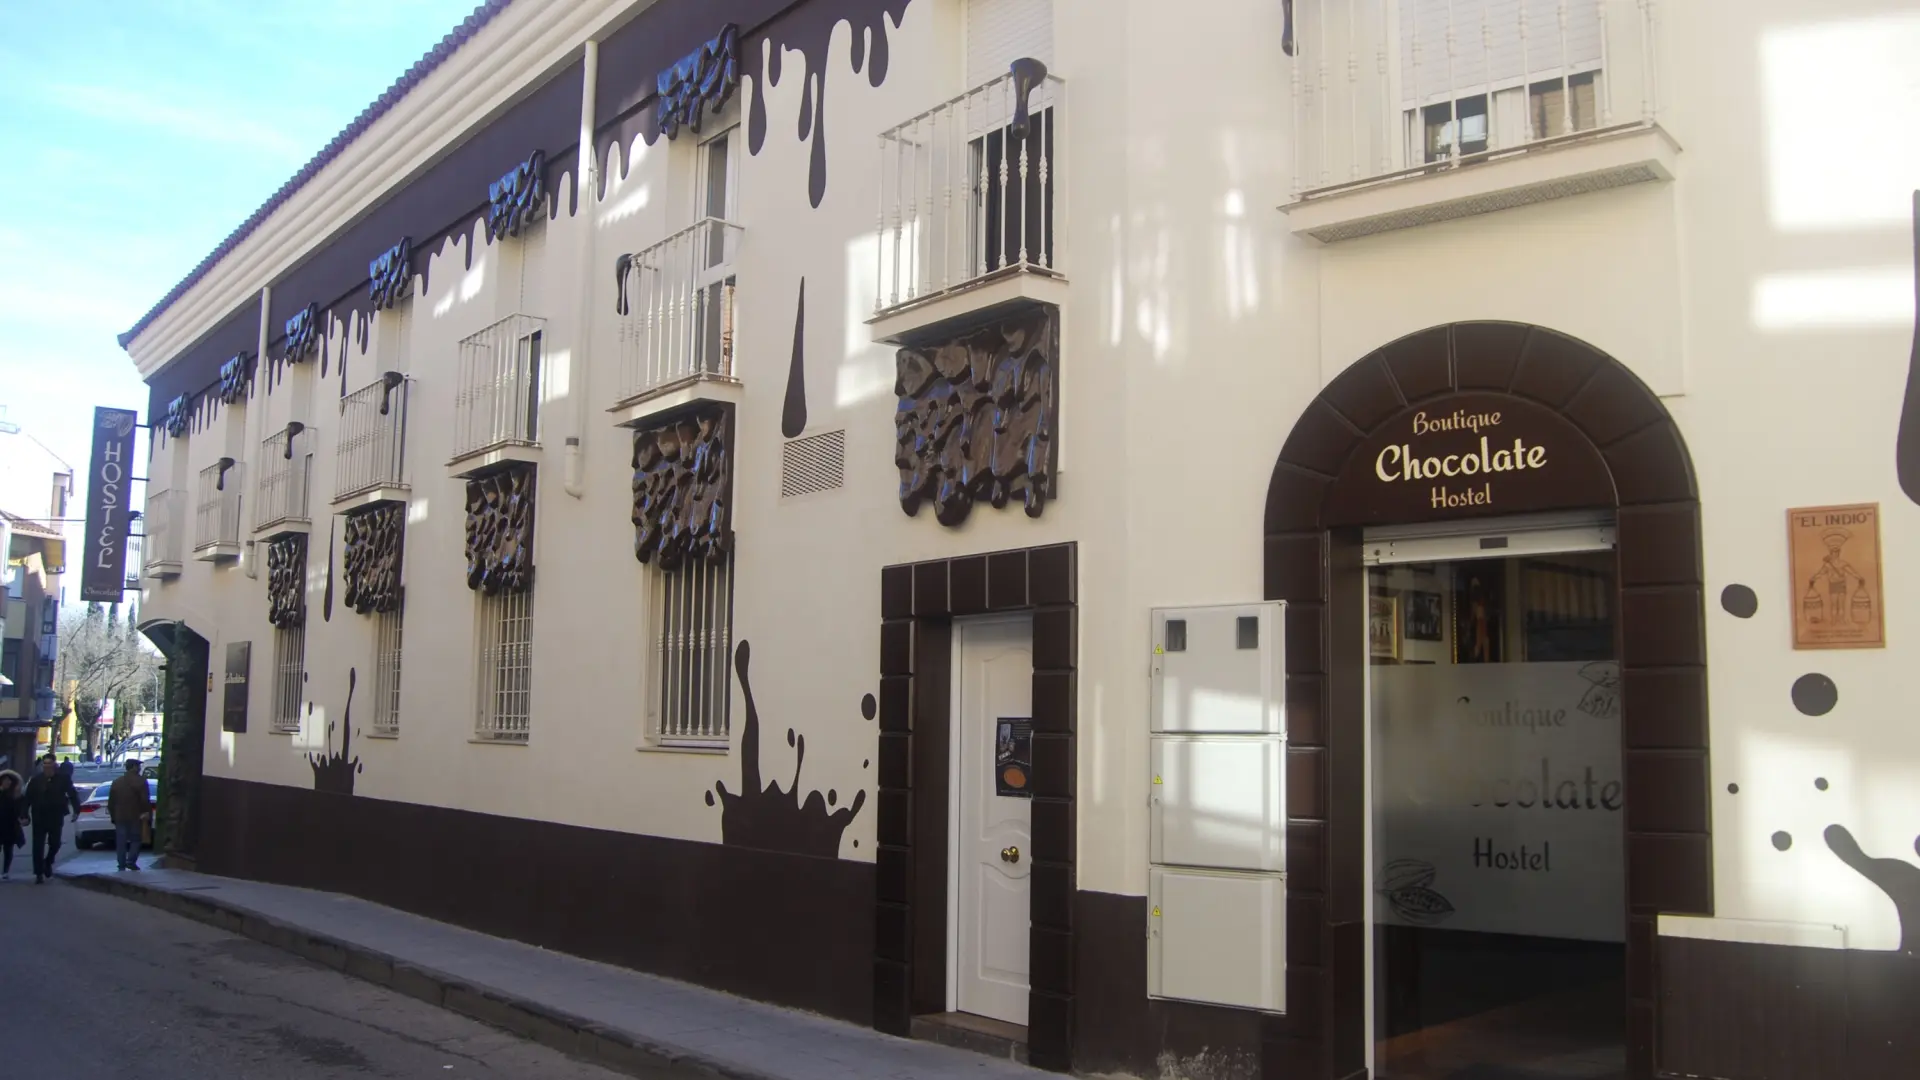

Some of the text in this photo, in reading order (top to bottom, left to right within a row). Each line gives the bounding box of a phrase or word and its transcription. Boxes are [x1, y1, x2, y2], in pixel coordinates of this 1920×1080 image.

[1413, 409, 1502, 436] Boutique
[1375, 436, 1548, 482] Chocolate
[97, 440, 122, 569] HOSTEL
[1430, 483, 1492, 509] Hostel
[1473, 836, 1550, 872] Hostel
